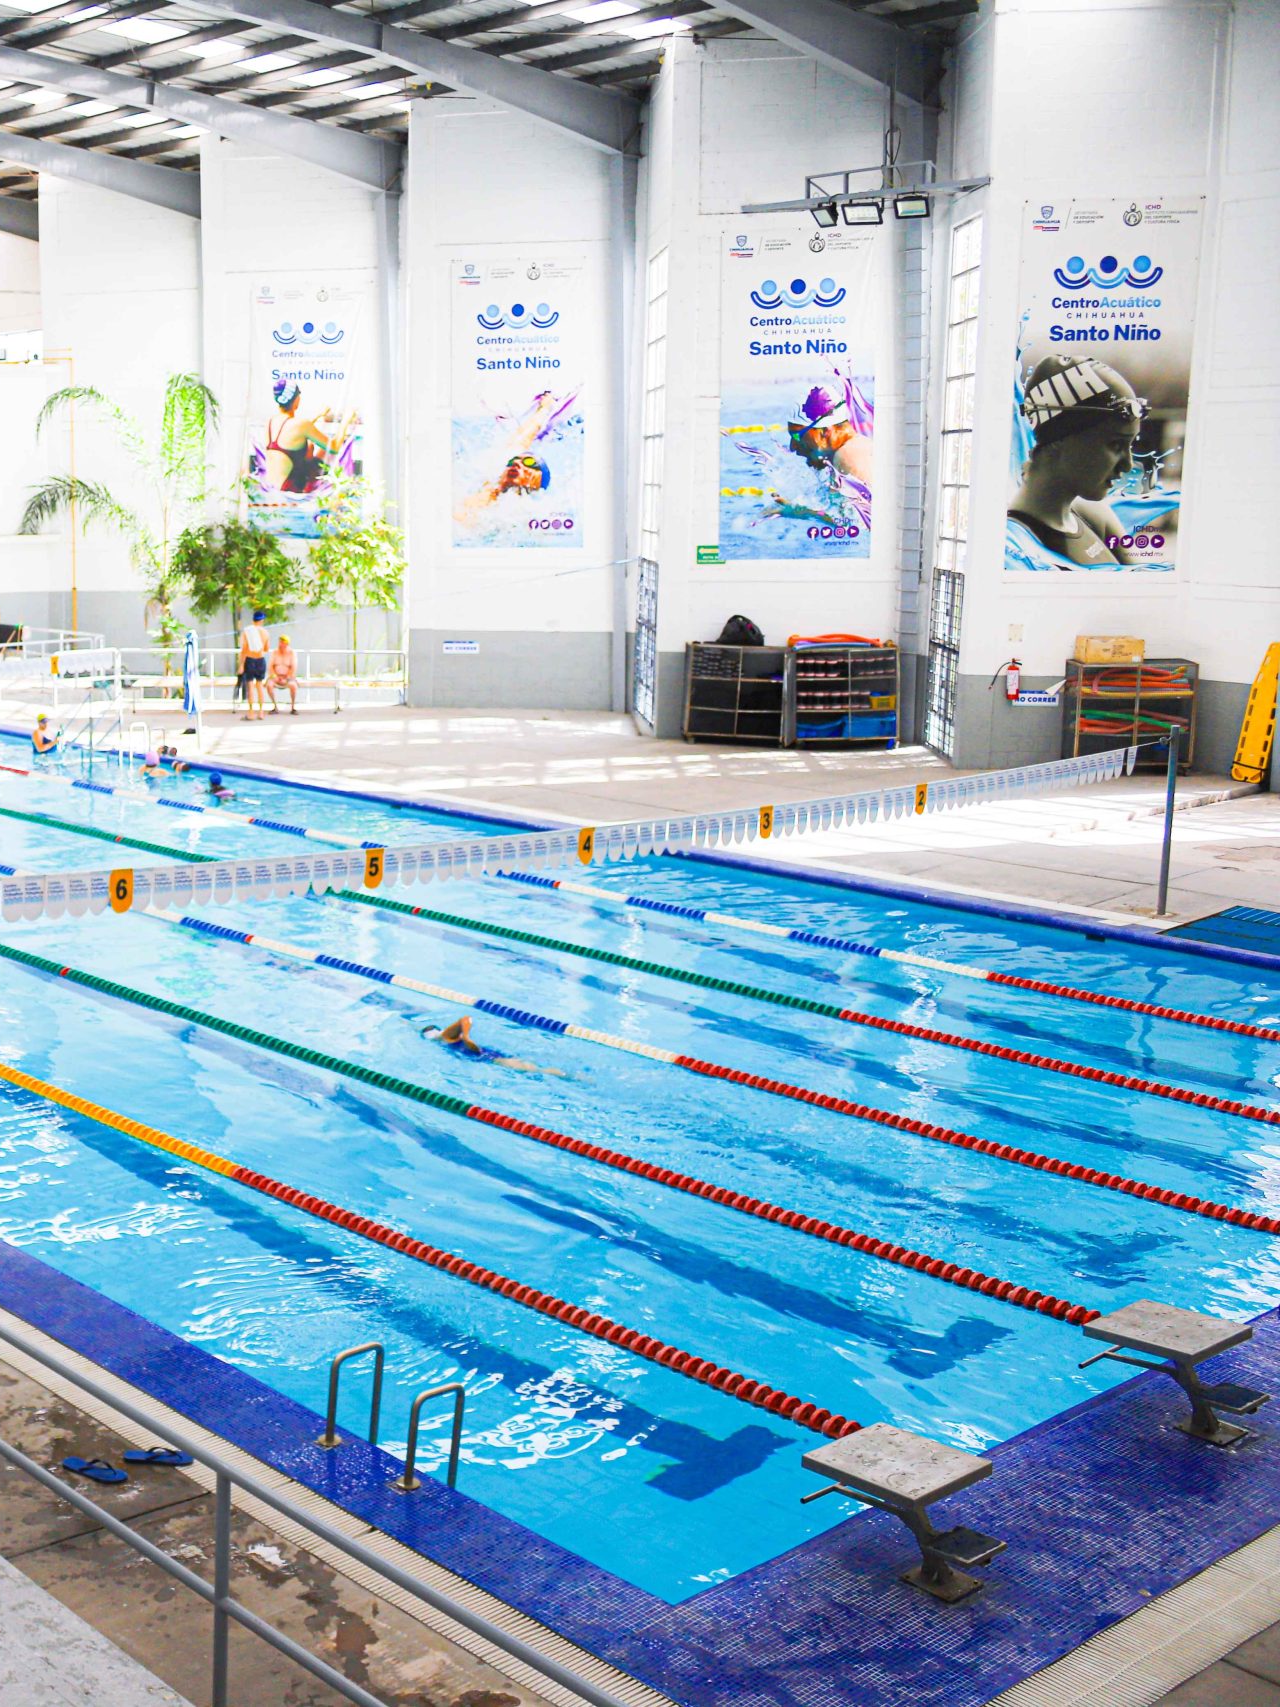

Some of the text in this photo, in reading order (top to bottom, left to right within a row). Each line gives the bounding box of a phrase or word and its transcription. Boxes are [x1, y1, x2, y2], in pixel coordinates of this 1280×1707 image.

[1051, 296, 1161, 309] CentroAcuático
[750, 315, 846, 327] CentroAcuático
[763, 328, 832, 336] CHIHUAHUA
[1049, 324, 1161, 342] Santo Niño
[749, 339, 847, 356] Santo Niño
[476, 356, 561, 370] Santo Niño
[272, 369, 311, 380] Santo
[918, 791, 925, 807] 2
[763, 812, 770, 829] 3
[583, 835, 591, 853] 4
[369, 857, 379, 877] 5
[115, 879, 128, 900] 6
